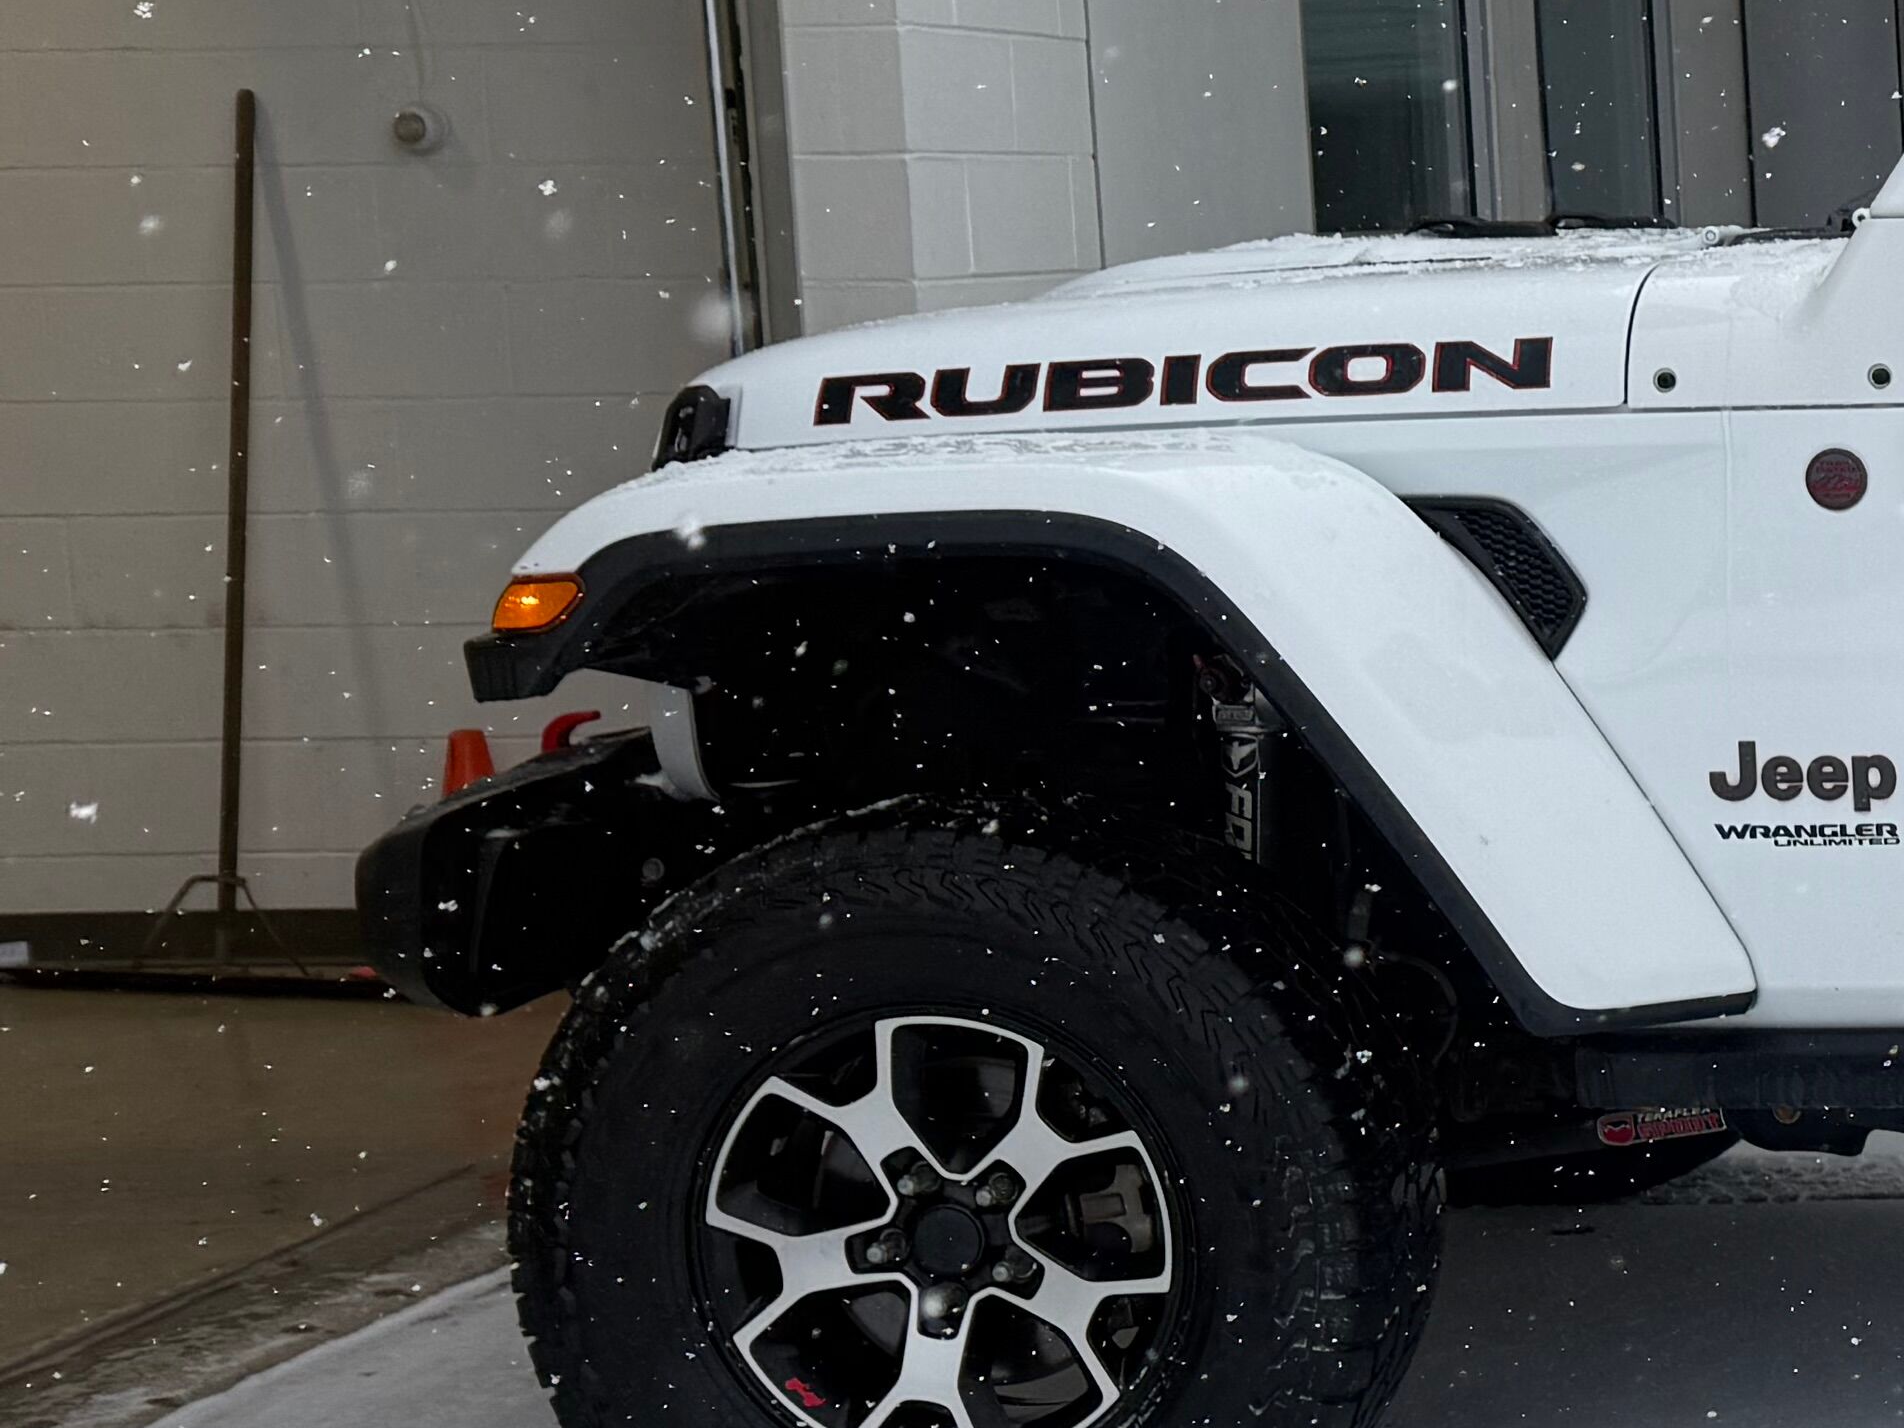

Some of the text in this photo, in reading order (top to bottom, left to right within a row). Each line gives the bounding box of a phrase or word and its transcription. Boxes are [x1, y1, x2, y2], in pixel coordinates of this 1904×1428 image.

[813, 336, 1554, 427] RUBICON
[1708, 740, 1898, 812] Jeep
[1224, 781, 1253, 861] FO
[1714, 823, 1900, 840] WRANGLER
[1773, 837, 1901, 847] UNLIMITED
